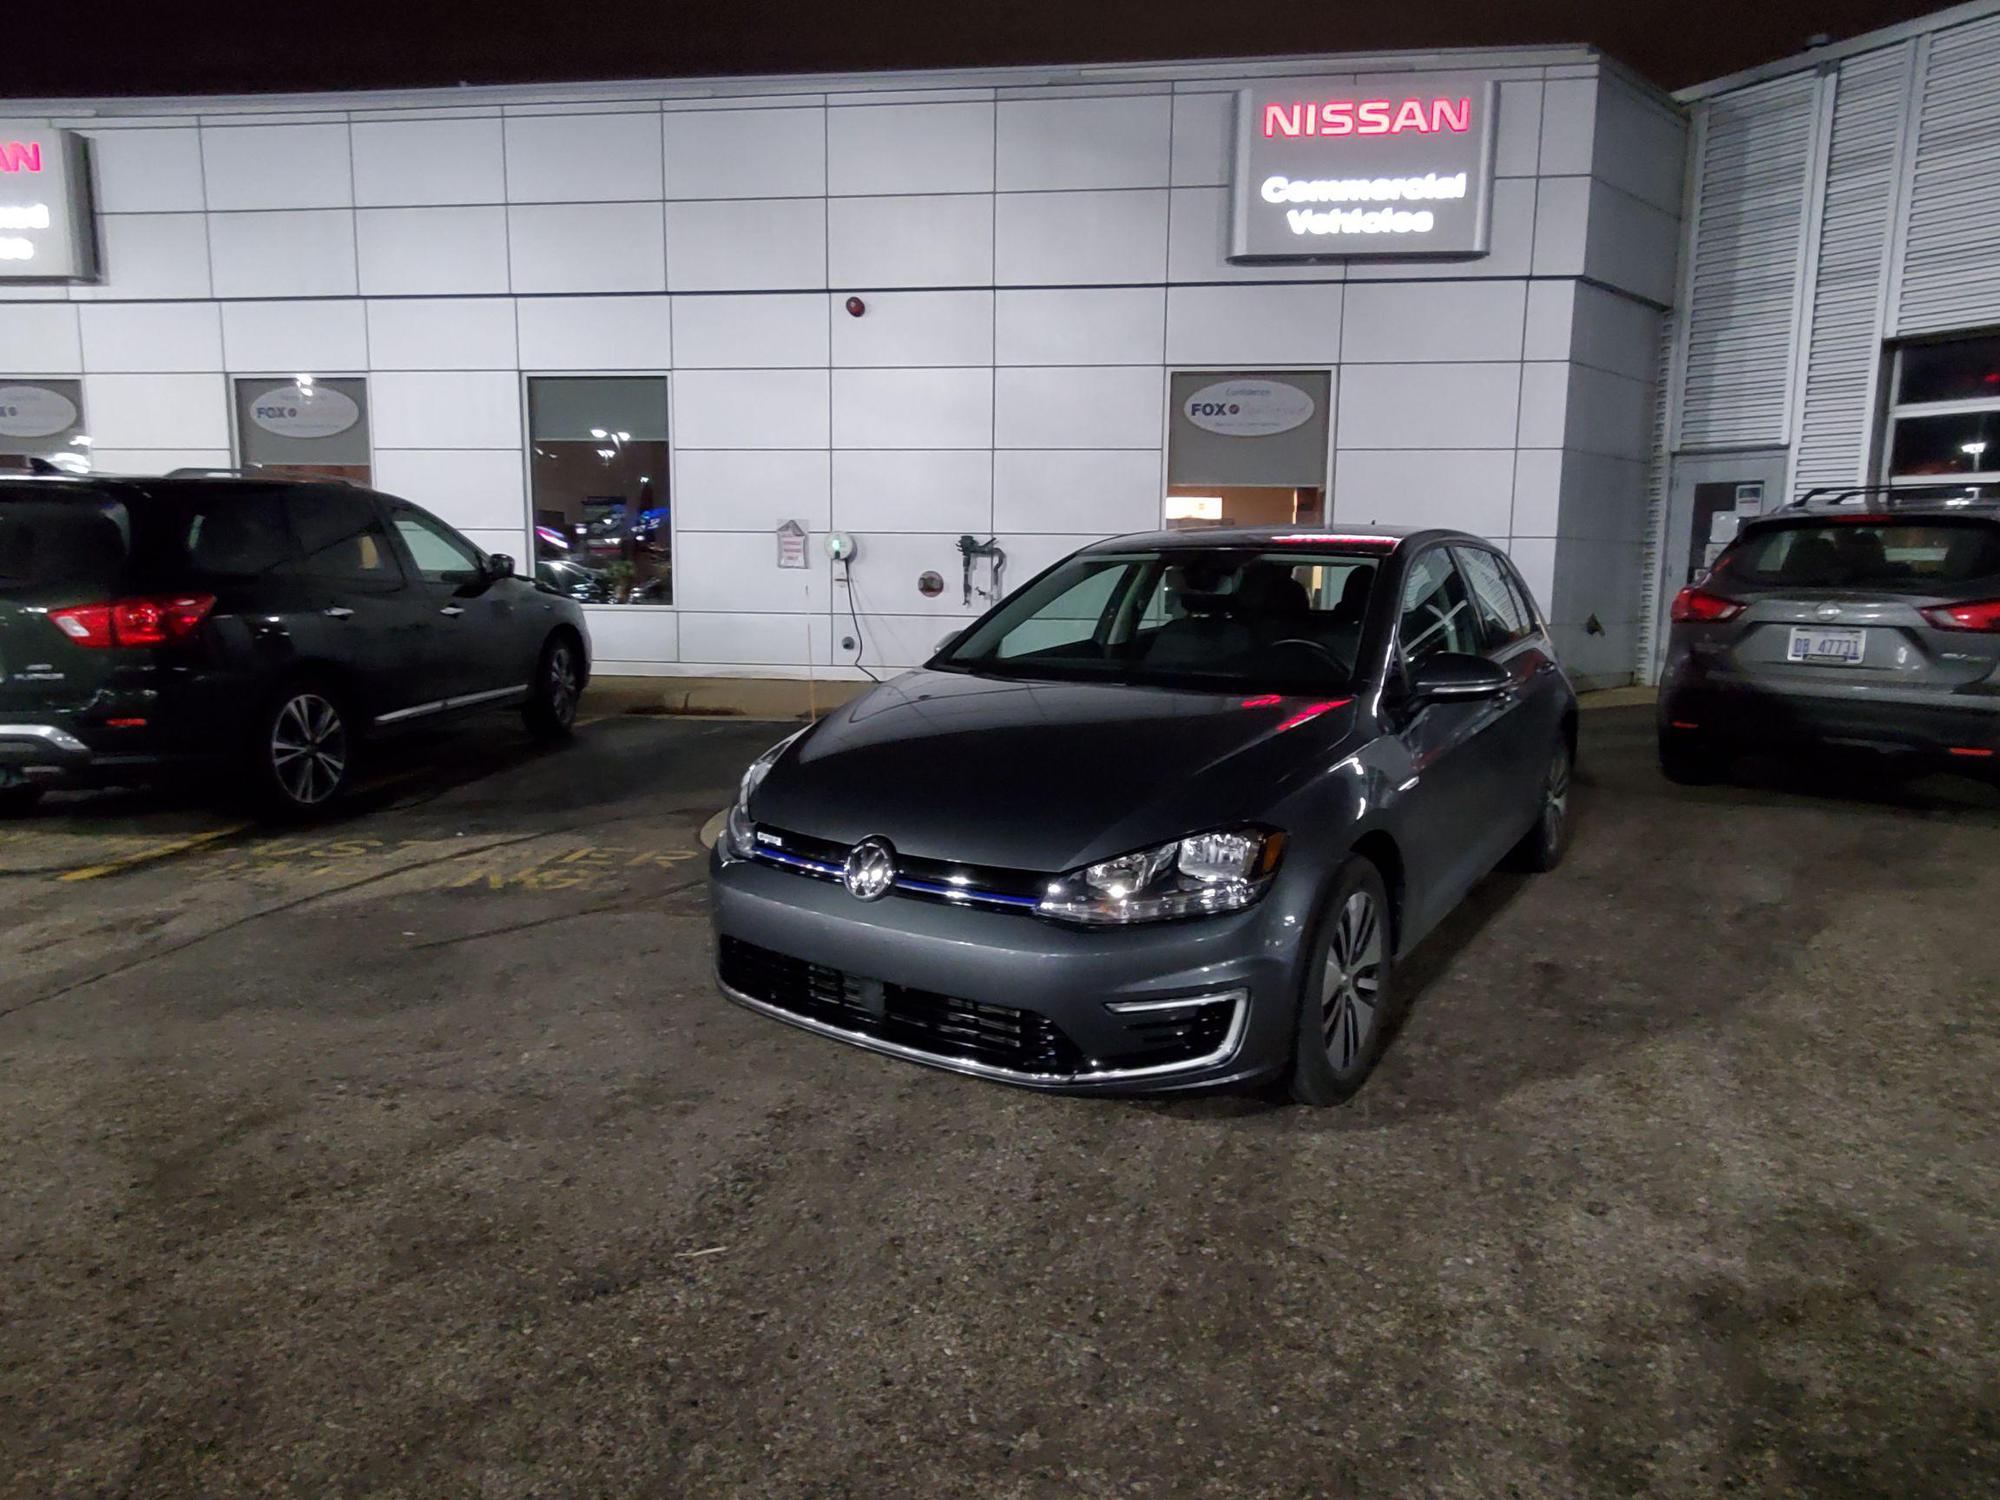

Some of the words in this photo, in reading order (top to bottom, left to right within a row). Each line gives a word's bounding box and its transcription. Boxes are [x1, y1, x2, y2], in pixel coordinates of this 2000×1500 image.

[1264, 98, 1470, 138] NISSAN
[256, 406, 287, 419] FOX
[1191, 403, 1227, 417] FOX
